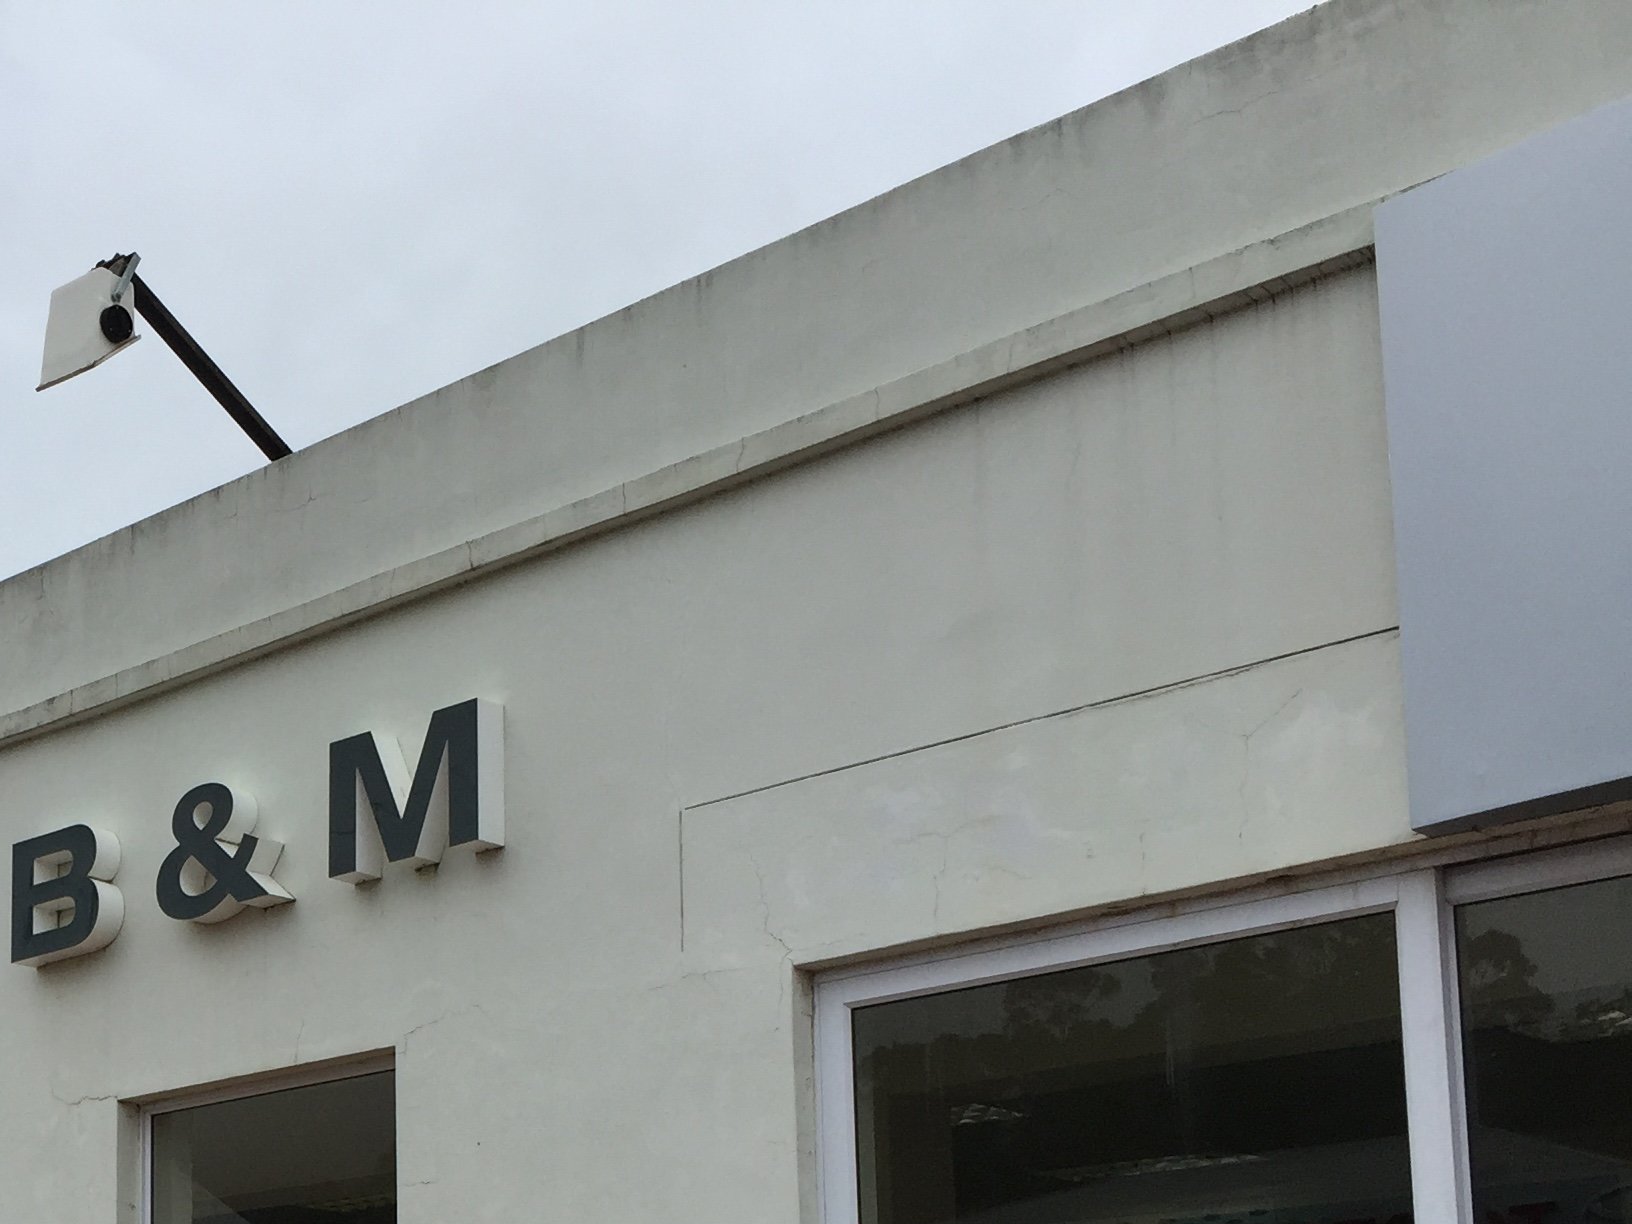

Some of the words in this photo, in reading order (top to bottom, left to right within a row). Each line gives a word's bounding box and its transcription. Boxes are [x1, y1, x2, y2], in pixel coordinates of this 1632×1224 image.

[11, 823, 101, 964] B
[156, 782, 270, 920] &
[328, 697, 480, 879] M
